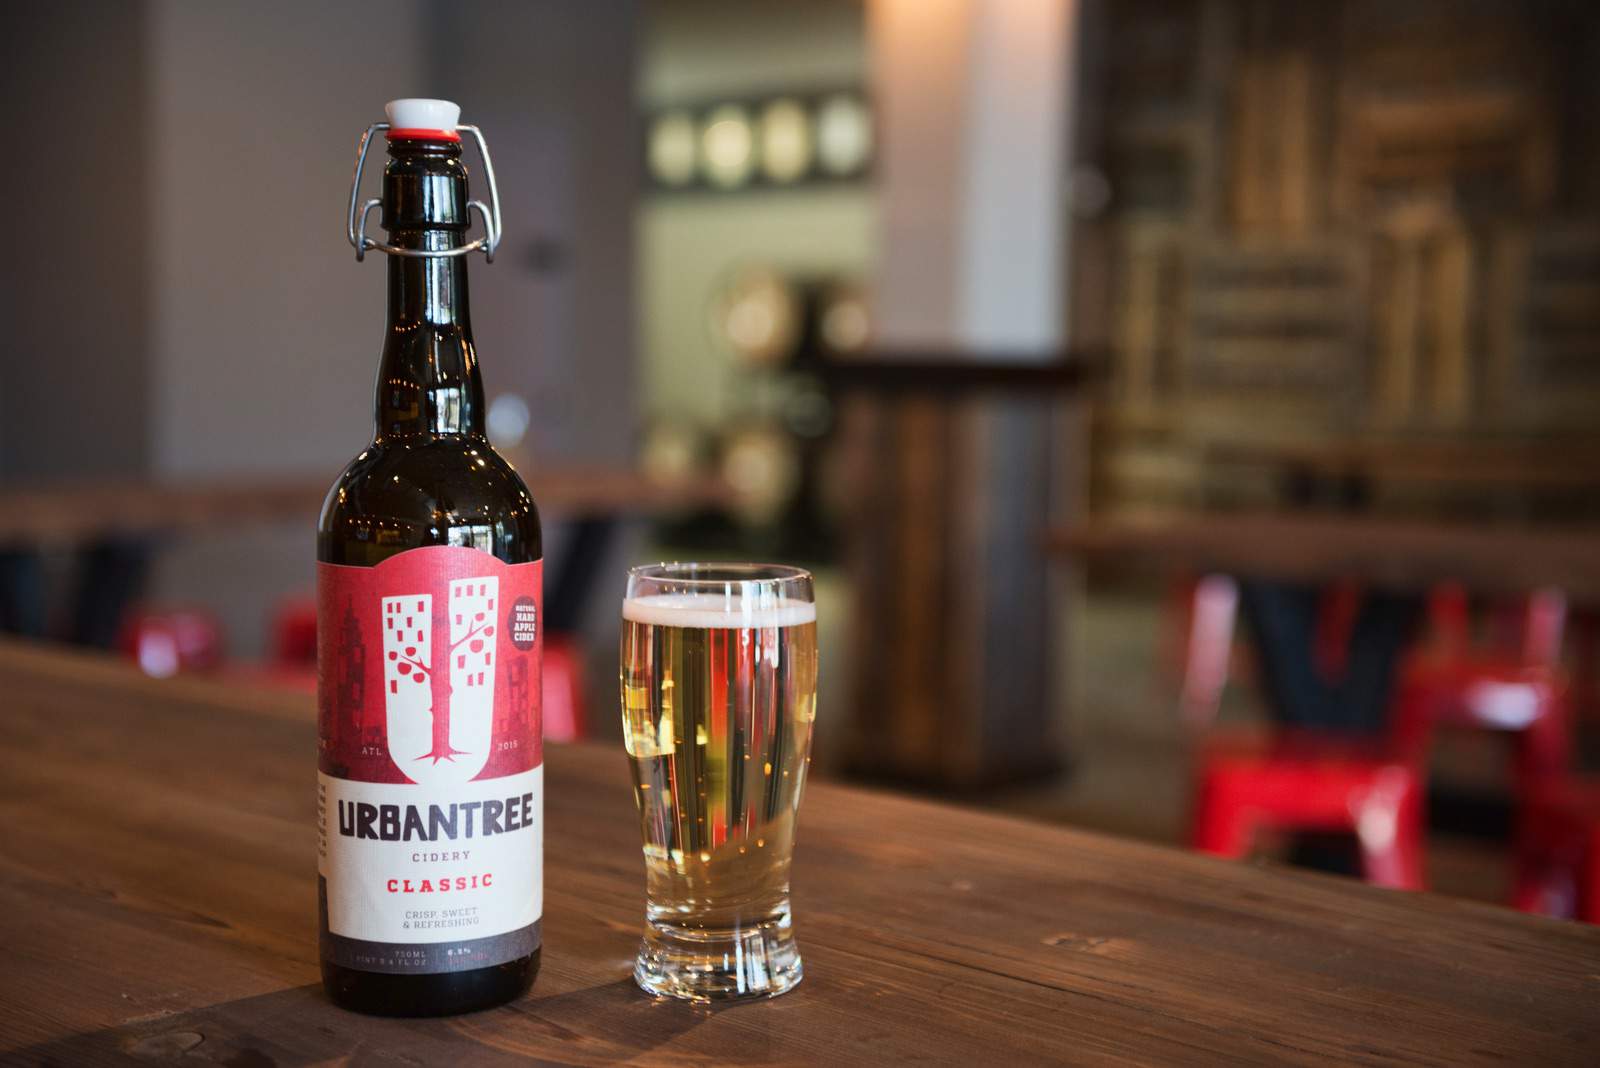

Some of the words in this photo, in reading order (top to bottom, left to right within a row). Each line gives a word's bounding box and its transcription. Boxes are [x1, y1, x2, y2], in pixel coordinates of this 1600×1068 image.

[516, 613, 535, 621] HARD
[514, 623, 535, 631] APPLE
[514, 632, 534, 641] CIDER
[497, 741, 519, 751] 2015
[361, 747, 382, 756] ATL
[338, 792, 533, 842] URBANTREE
[412, 851, 471, 862] CIDERY
[387, 873, 493, 893] CLASSIC
[442, 907, 478, 918] SWEET
[402, 921, 410, 929] &
[414, 917, 479, 929] REFRESHING
